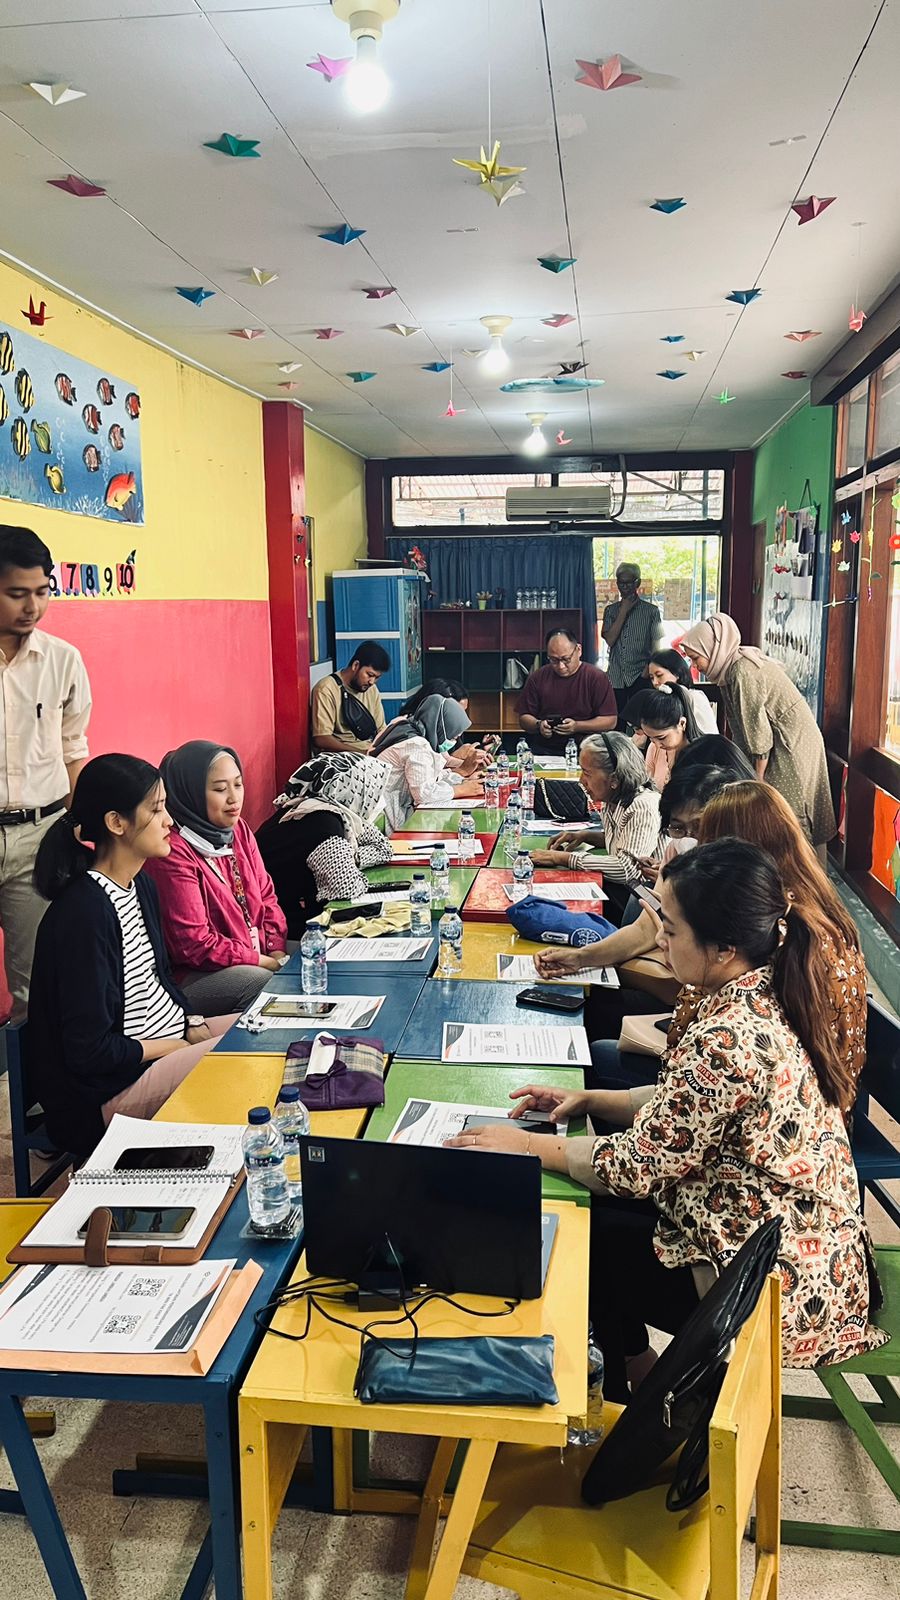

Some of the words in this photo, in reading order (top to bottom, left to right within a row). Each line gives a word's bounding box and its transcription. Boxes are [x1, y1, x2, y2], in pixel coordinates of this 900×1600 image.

[66, 563, 77, 590] 7
[85, 565, 95, 590] 8
[104, 567, 113, 592] 9
[119, 564, 135, 589] 10
[685, 1071, 701, 1091] MINI
[695, 1063, 720, 1086] KASUR
[695, 1073, 709, 1086] PAK
[701, 1088, 714, 1096] TK
[722, 1156, 744, 1169] MINI
[717, 1251, 729, 1261] TK
